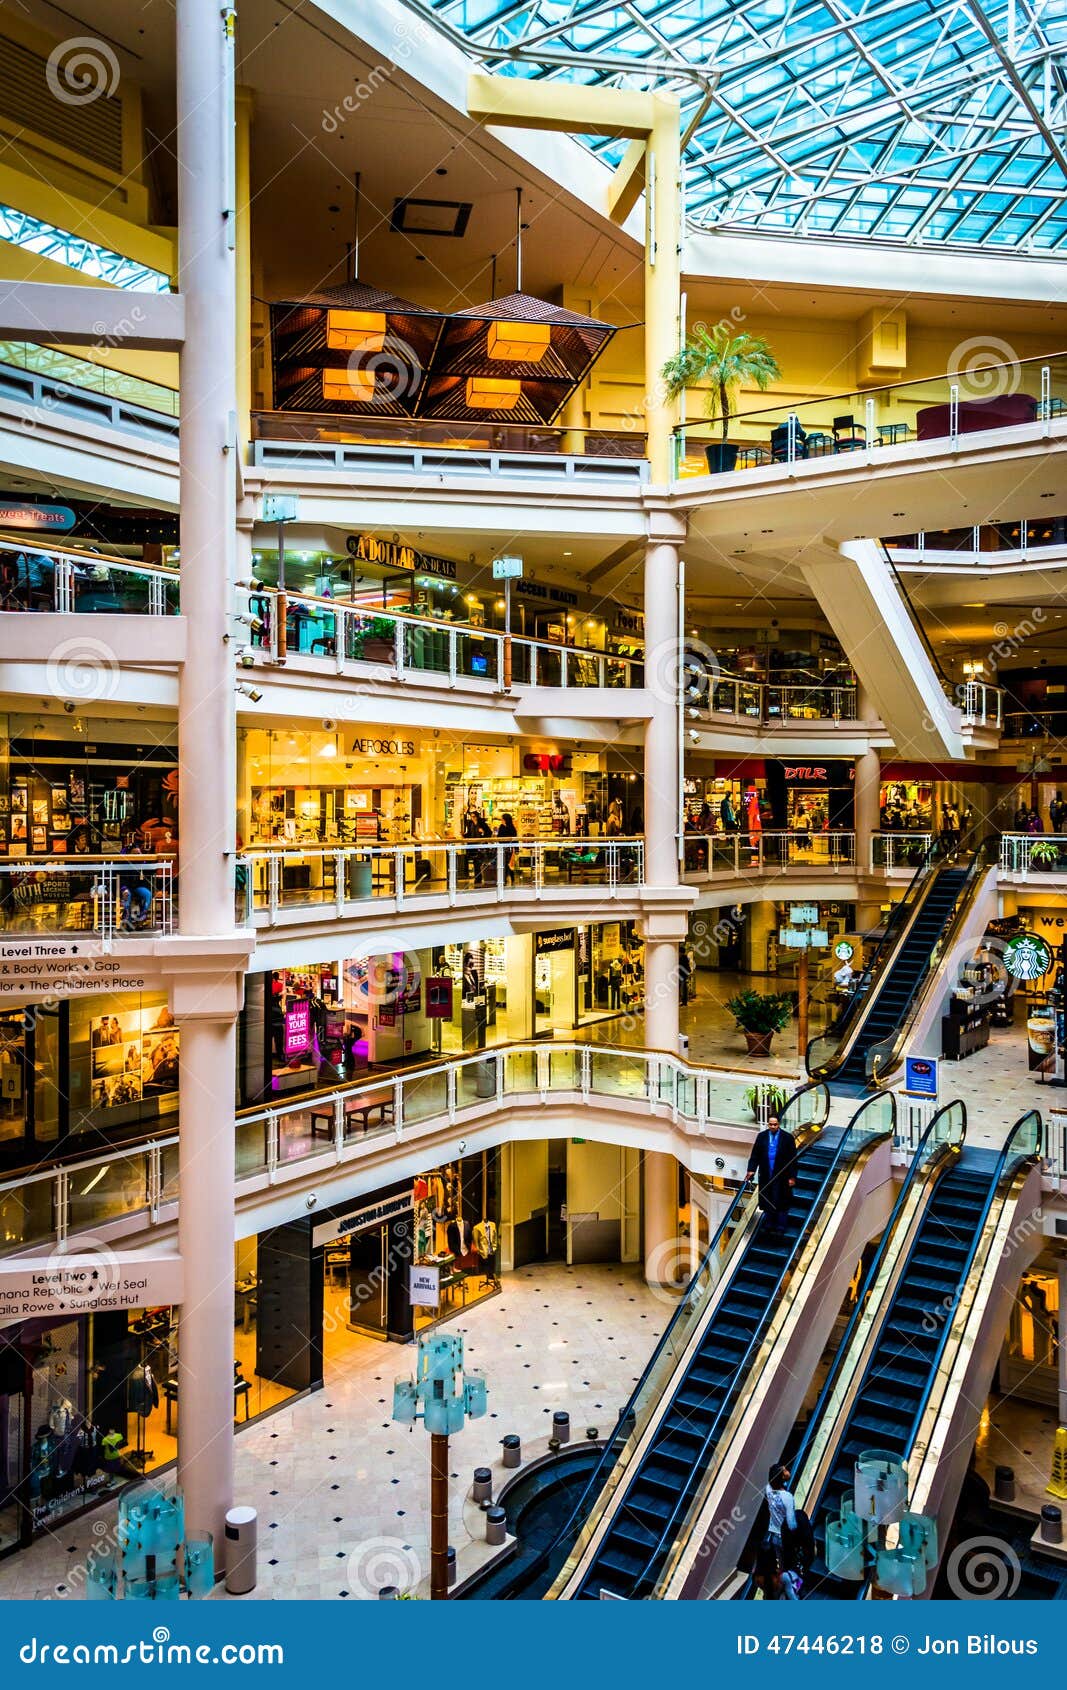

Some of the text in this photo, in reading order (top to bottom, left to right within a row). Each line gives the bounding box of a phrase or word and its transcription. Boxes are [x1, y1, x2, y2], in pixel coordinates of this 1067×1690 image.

[30, 510, 65, 522] Treats
[369, 538, 416, 571] DOLLAR
[352, 738, 415, 755] AEROSOLES
[784, 766, 828, 780] DTLR
[12, 883, 42, 900] RUTH
[1, 945, 66, 957] Level Three
[14, 963, 43, 976] Body
[46, 962, 79, 973] Works
[94, 961, 121, 974] Gap
[30, 980, 50, 991] The
[53, 979, 110, 990] Children's
[113, 977, 145, 988] Place
[288, 1013, 297, 1021] WE
[288, 1019, 307, 1030] YOUR
[288, 1034, 307, 1047] FEES
[32, 1271, 88, 1285] Level Two
[419, 1276, 430, 1284] NEW
[33, 1284, 83, 1297] Republic
[100, 1281, 121, 1291] Wet
[124, 1278, 148, 1290] Seal
[22, 1302, 55, 1313] Rowe
[69, 1297, 118, 1310] Sunglass
[120, 1294, 139, 1305] Hut
